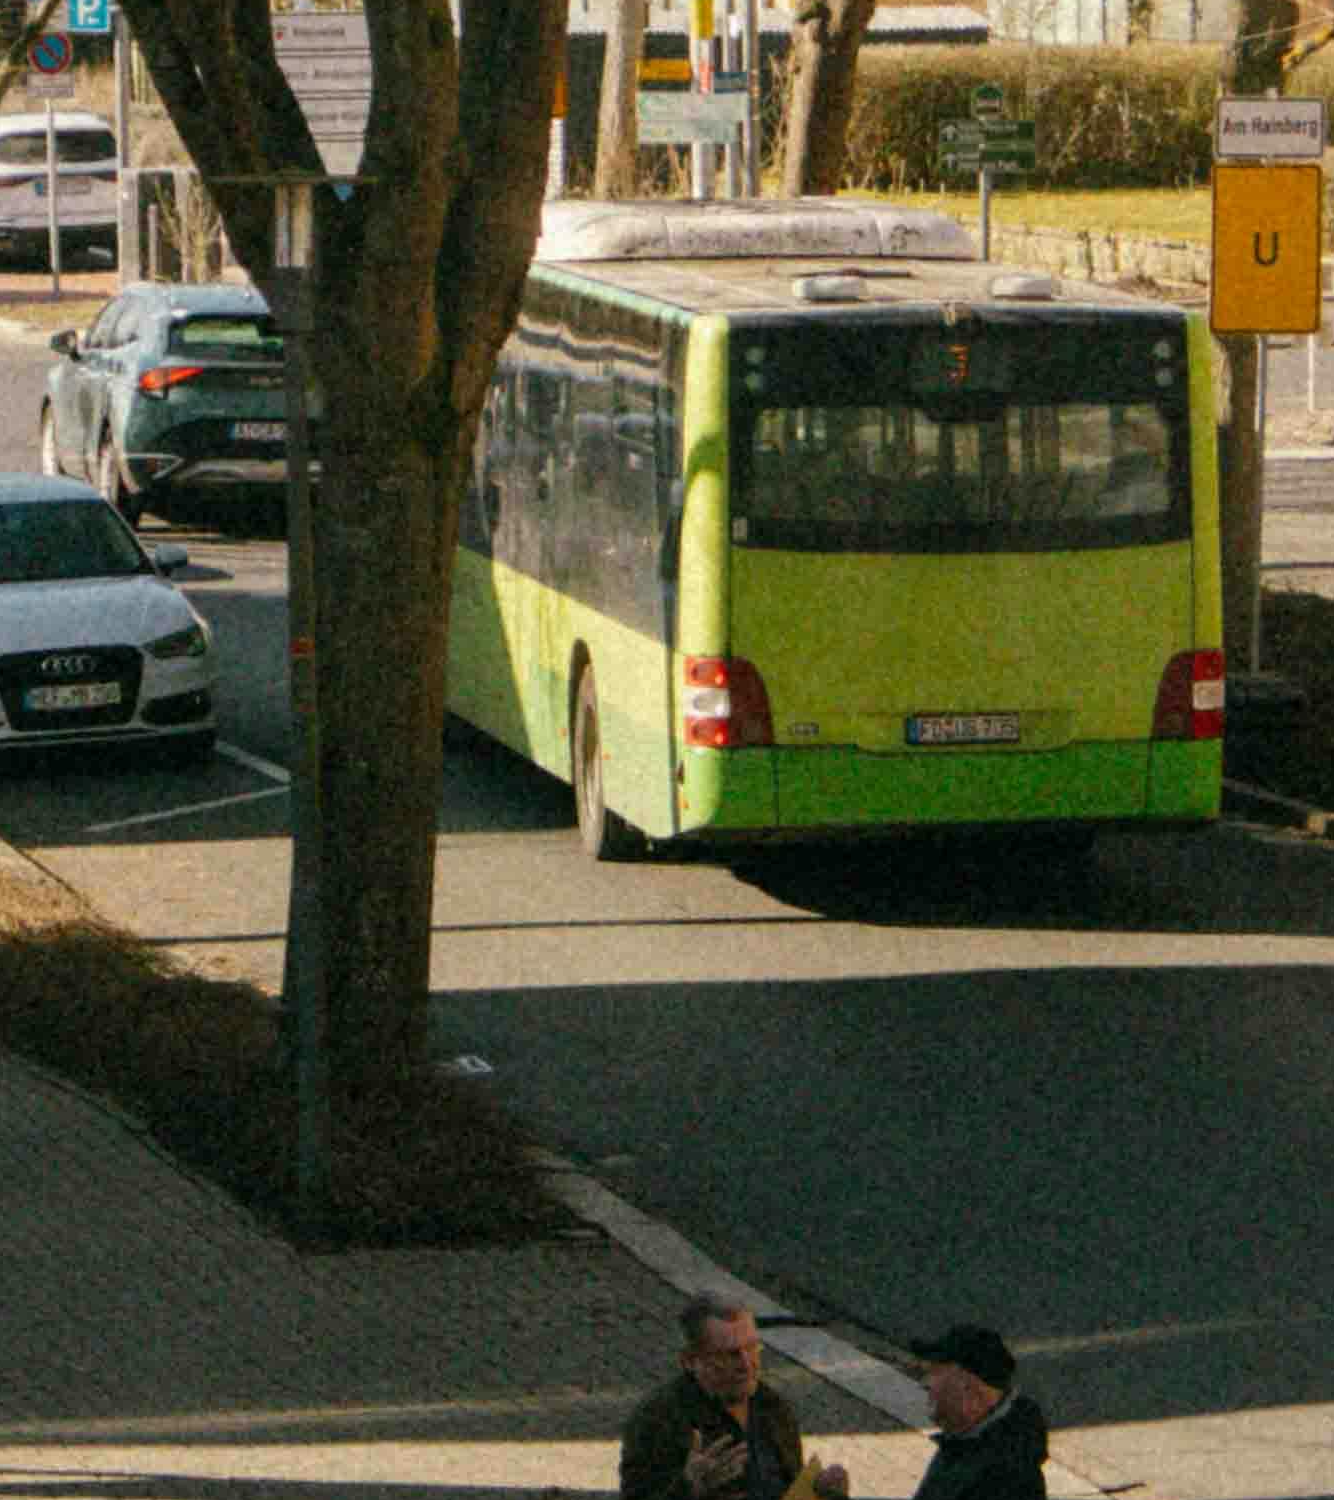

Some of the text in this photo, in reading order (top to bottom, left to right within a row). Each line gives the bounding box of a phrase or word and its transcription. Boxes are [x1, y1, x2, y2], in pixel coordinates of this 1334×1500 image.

[1223, 115, 1318, 139] Am Hainberg
[1253, 231, 1278, 266] U
